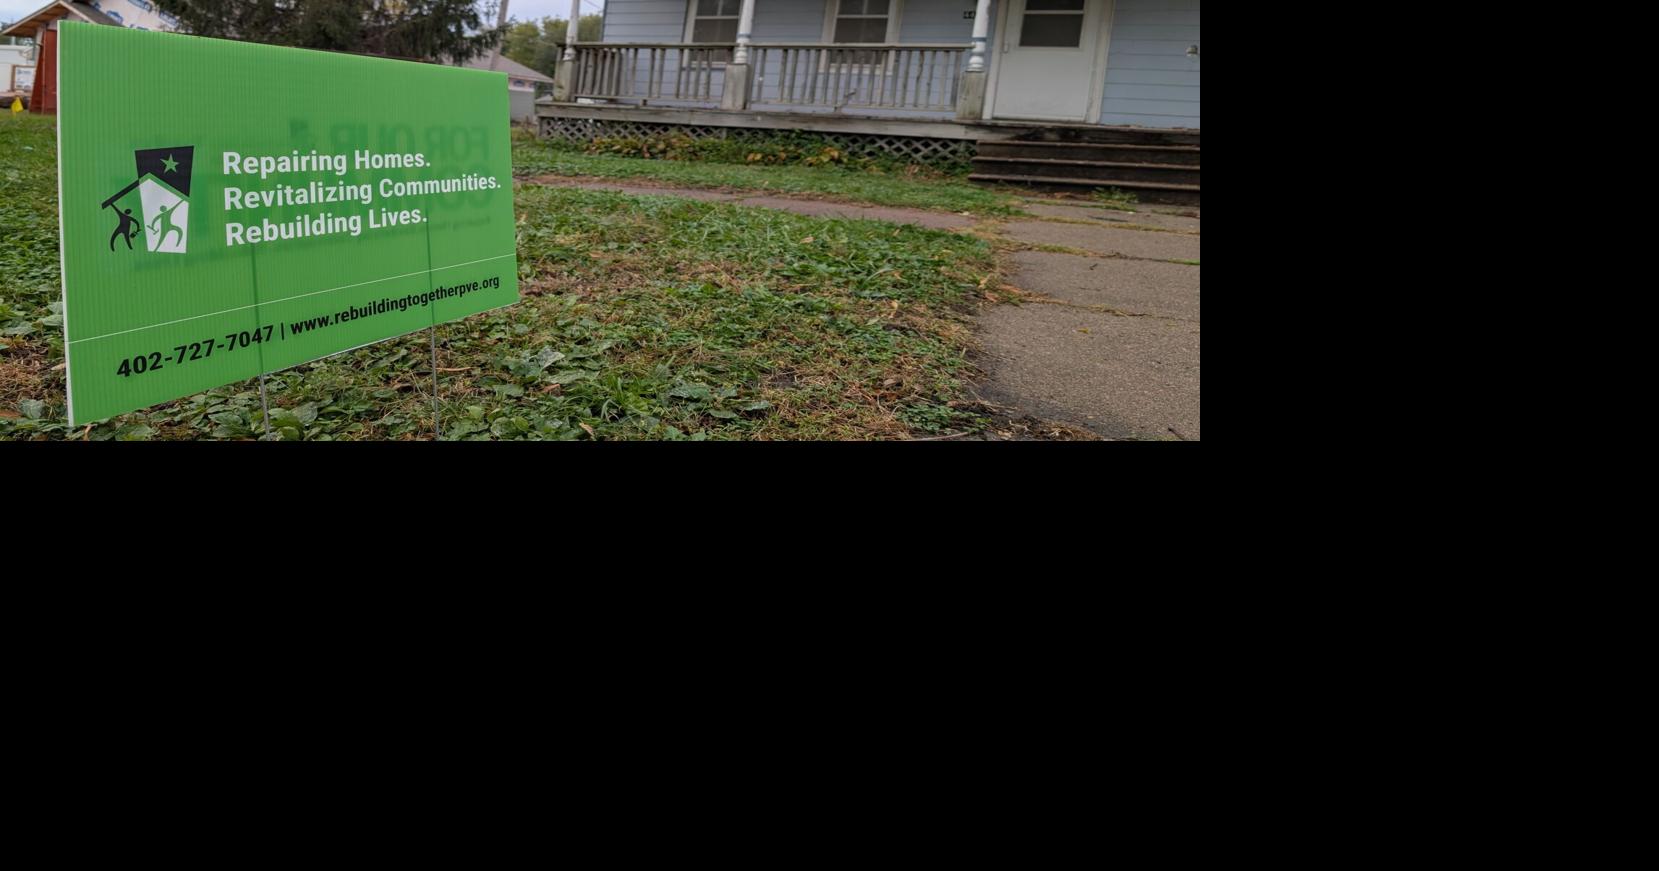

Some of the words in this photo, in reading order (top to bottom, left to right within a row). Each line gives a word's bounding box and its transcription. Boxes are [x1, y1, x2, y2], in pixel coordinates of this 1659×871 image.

[223, 150, 347, 179] Repairing
[354, 150, 431, 170] Homes.
[223, 180, 373, 211] Revitalizing
[379, 172, 502, 198] Communities.
[225, 213, 362, 247] Rebuilding
[368, 207, 427, 229] Lives.
[116, 325, 275, 378] 402-727-7047
[290, 276, 501, 336] www.rebuildingtogetherpve.org
